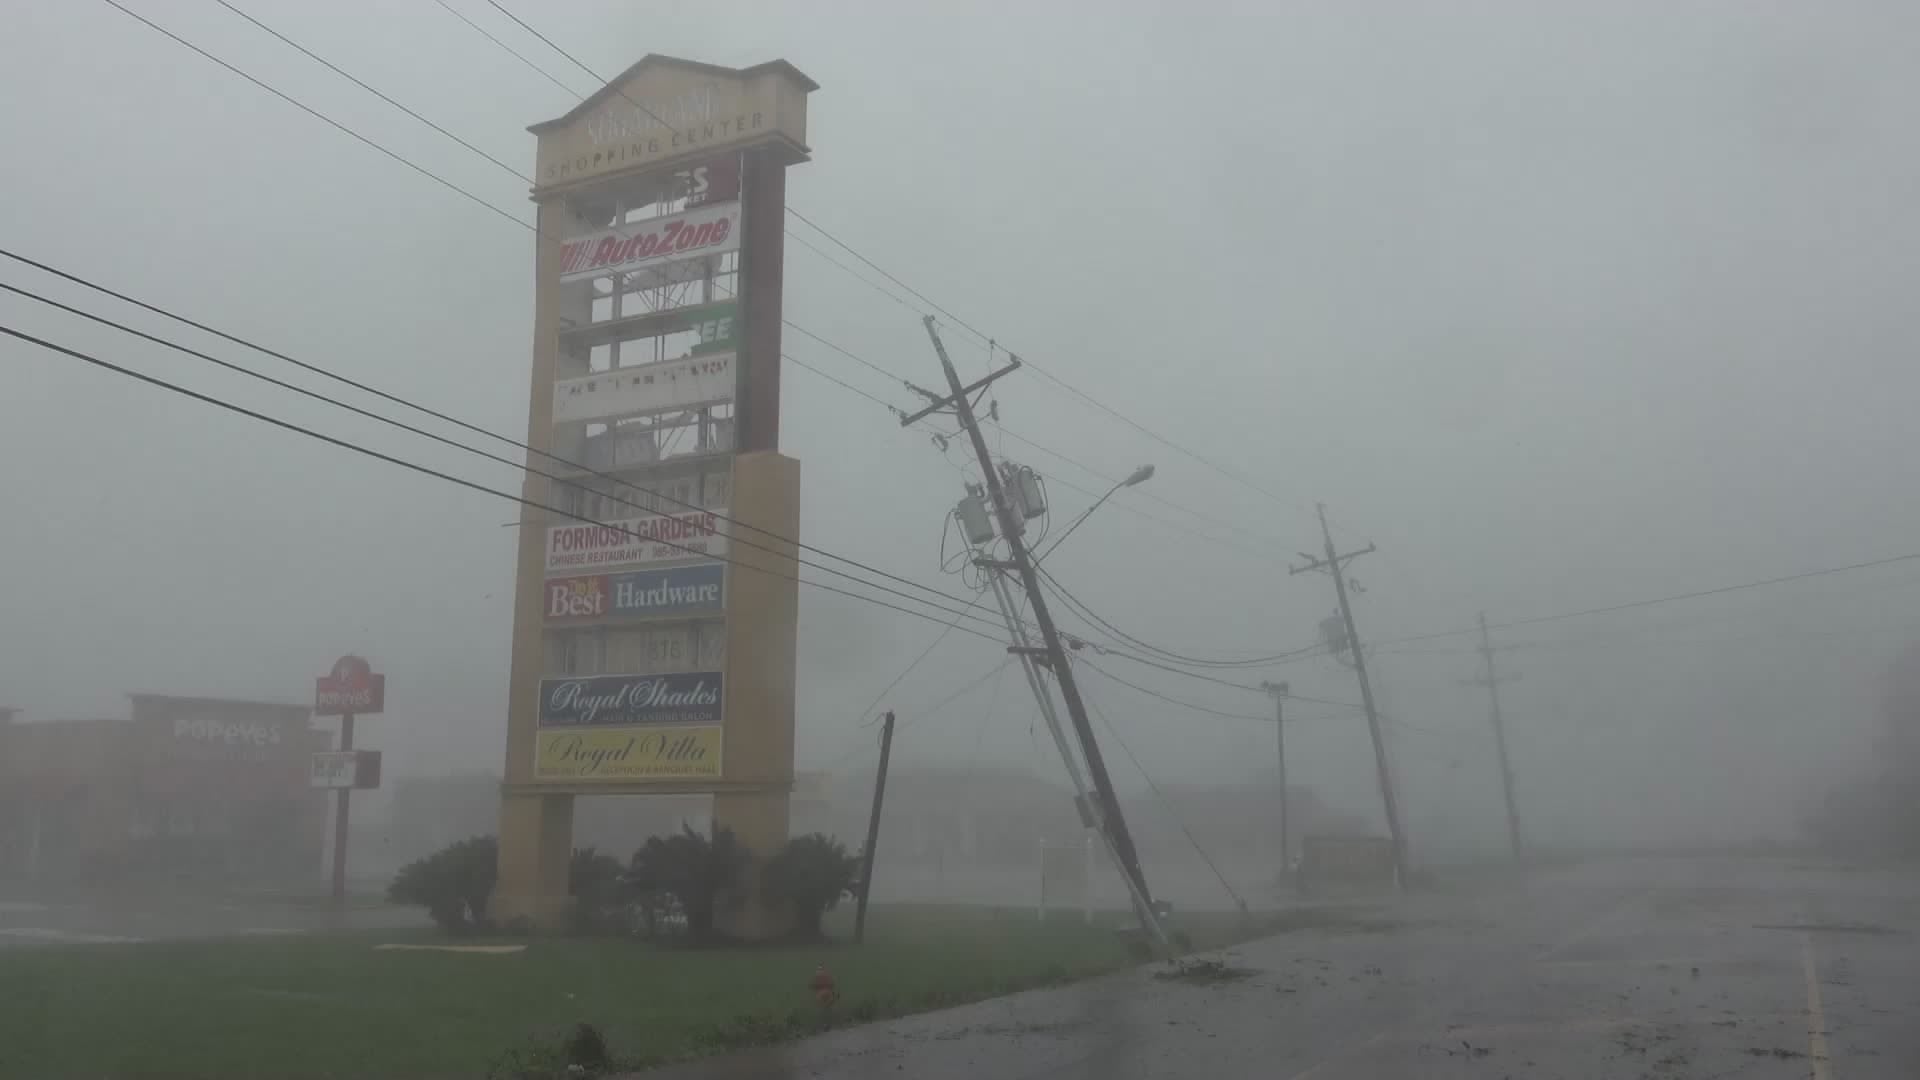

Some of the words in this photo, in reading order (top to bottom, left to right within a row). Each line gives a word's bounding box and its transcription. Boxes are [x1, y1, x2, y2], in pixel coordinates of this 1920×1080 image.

[545, 140, 660, 178] SHOPPING
[671, 111, 764, 147] CENTER
[592, 217, 730, 267] AutoZone
[552, 525, 632, 552] FORMOSA
[637, 512, 718, 543] GARDENS
[549, 552, 585, 567] CHINESE
[586, 549, 643, 564] RESTAURANT
[549, 584, 604, 617] Best
[616, 578, 719, 609] Hardware
[551, 680, 630, 721] Royal
[628, 678, 718, 712] Shades
[549, 734, 635, 776] Royal
[639, 735, 707, 761] Villa
